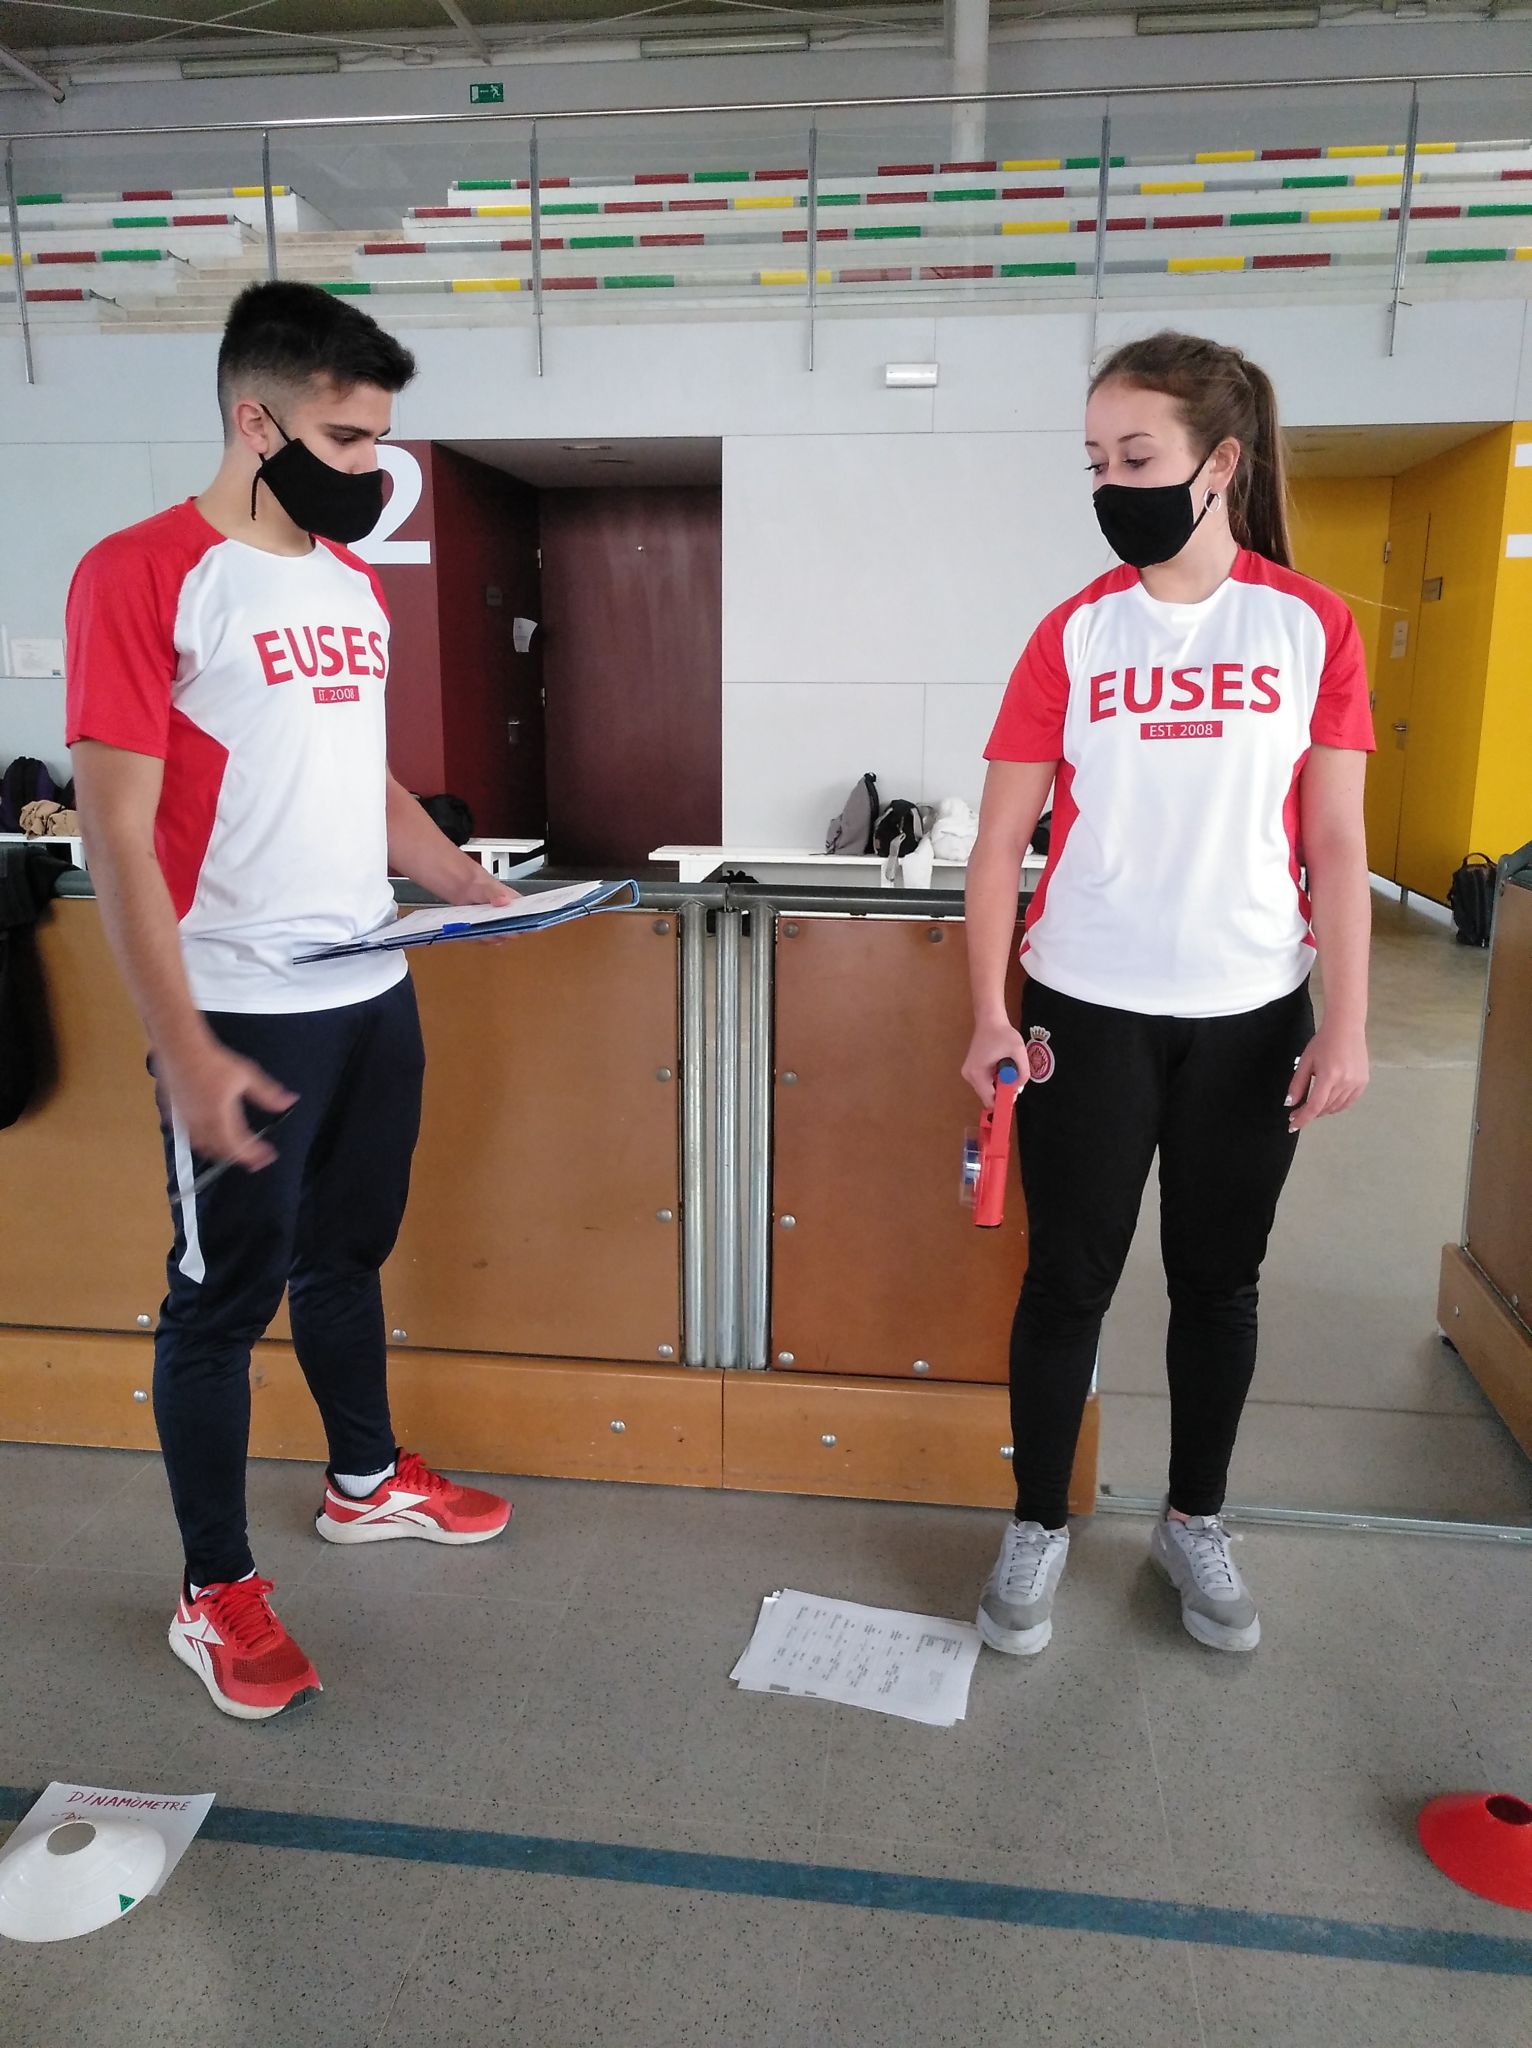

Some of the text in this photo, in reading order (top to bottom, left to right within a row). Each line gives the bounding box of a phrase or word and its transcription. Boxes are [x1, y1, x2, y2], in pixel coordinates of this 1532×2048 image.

[347, 444, 430, 564] 2
[253, 626, 385, 686] EUSES
[1090, 663, 1281, 723] EUSES
[1149, 723, 1214, 737] EST. 2008
